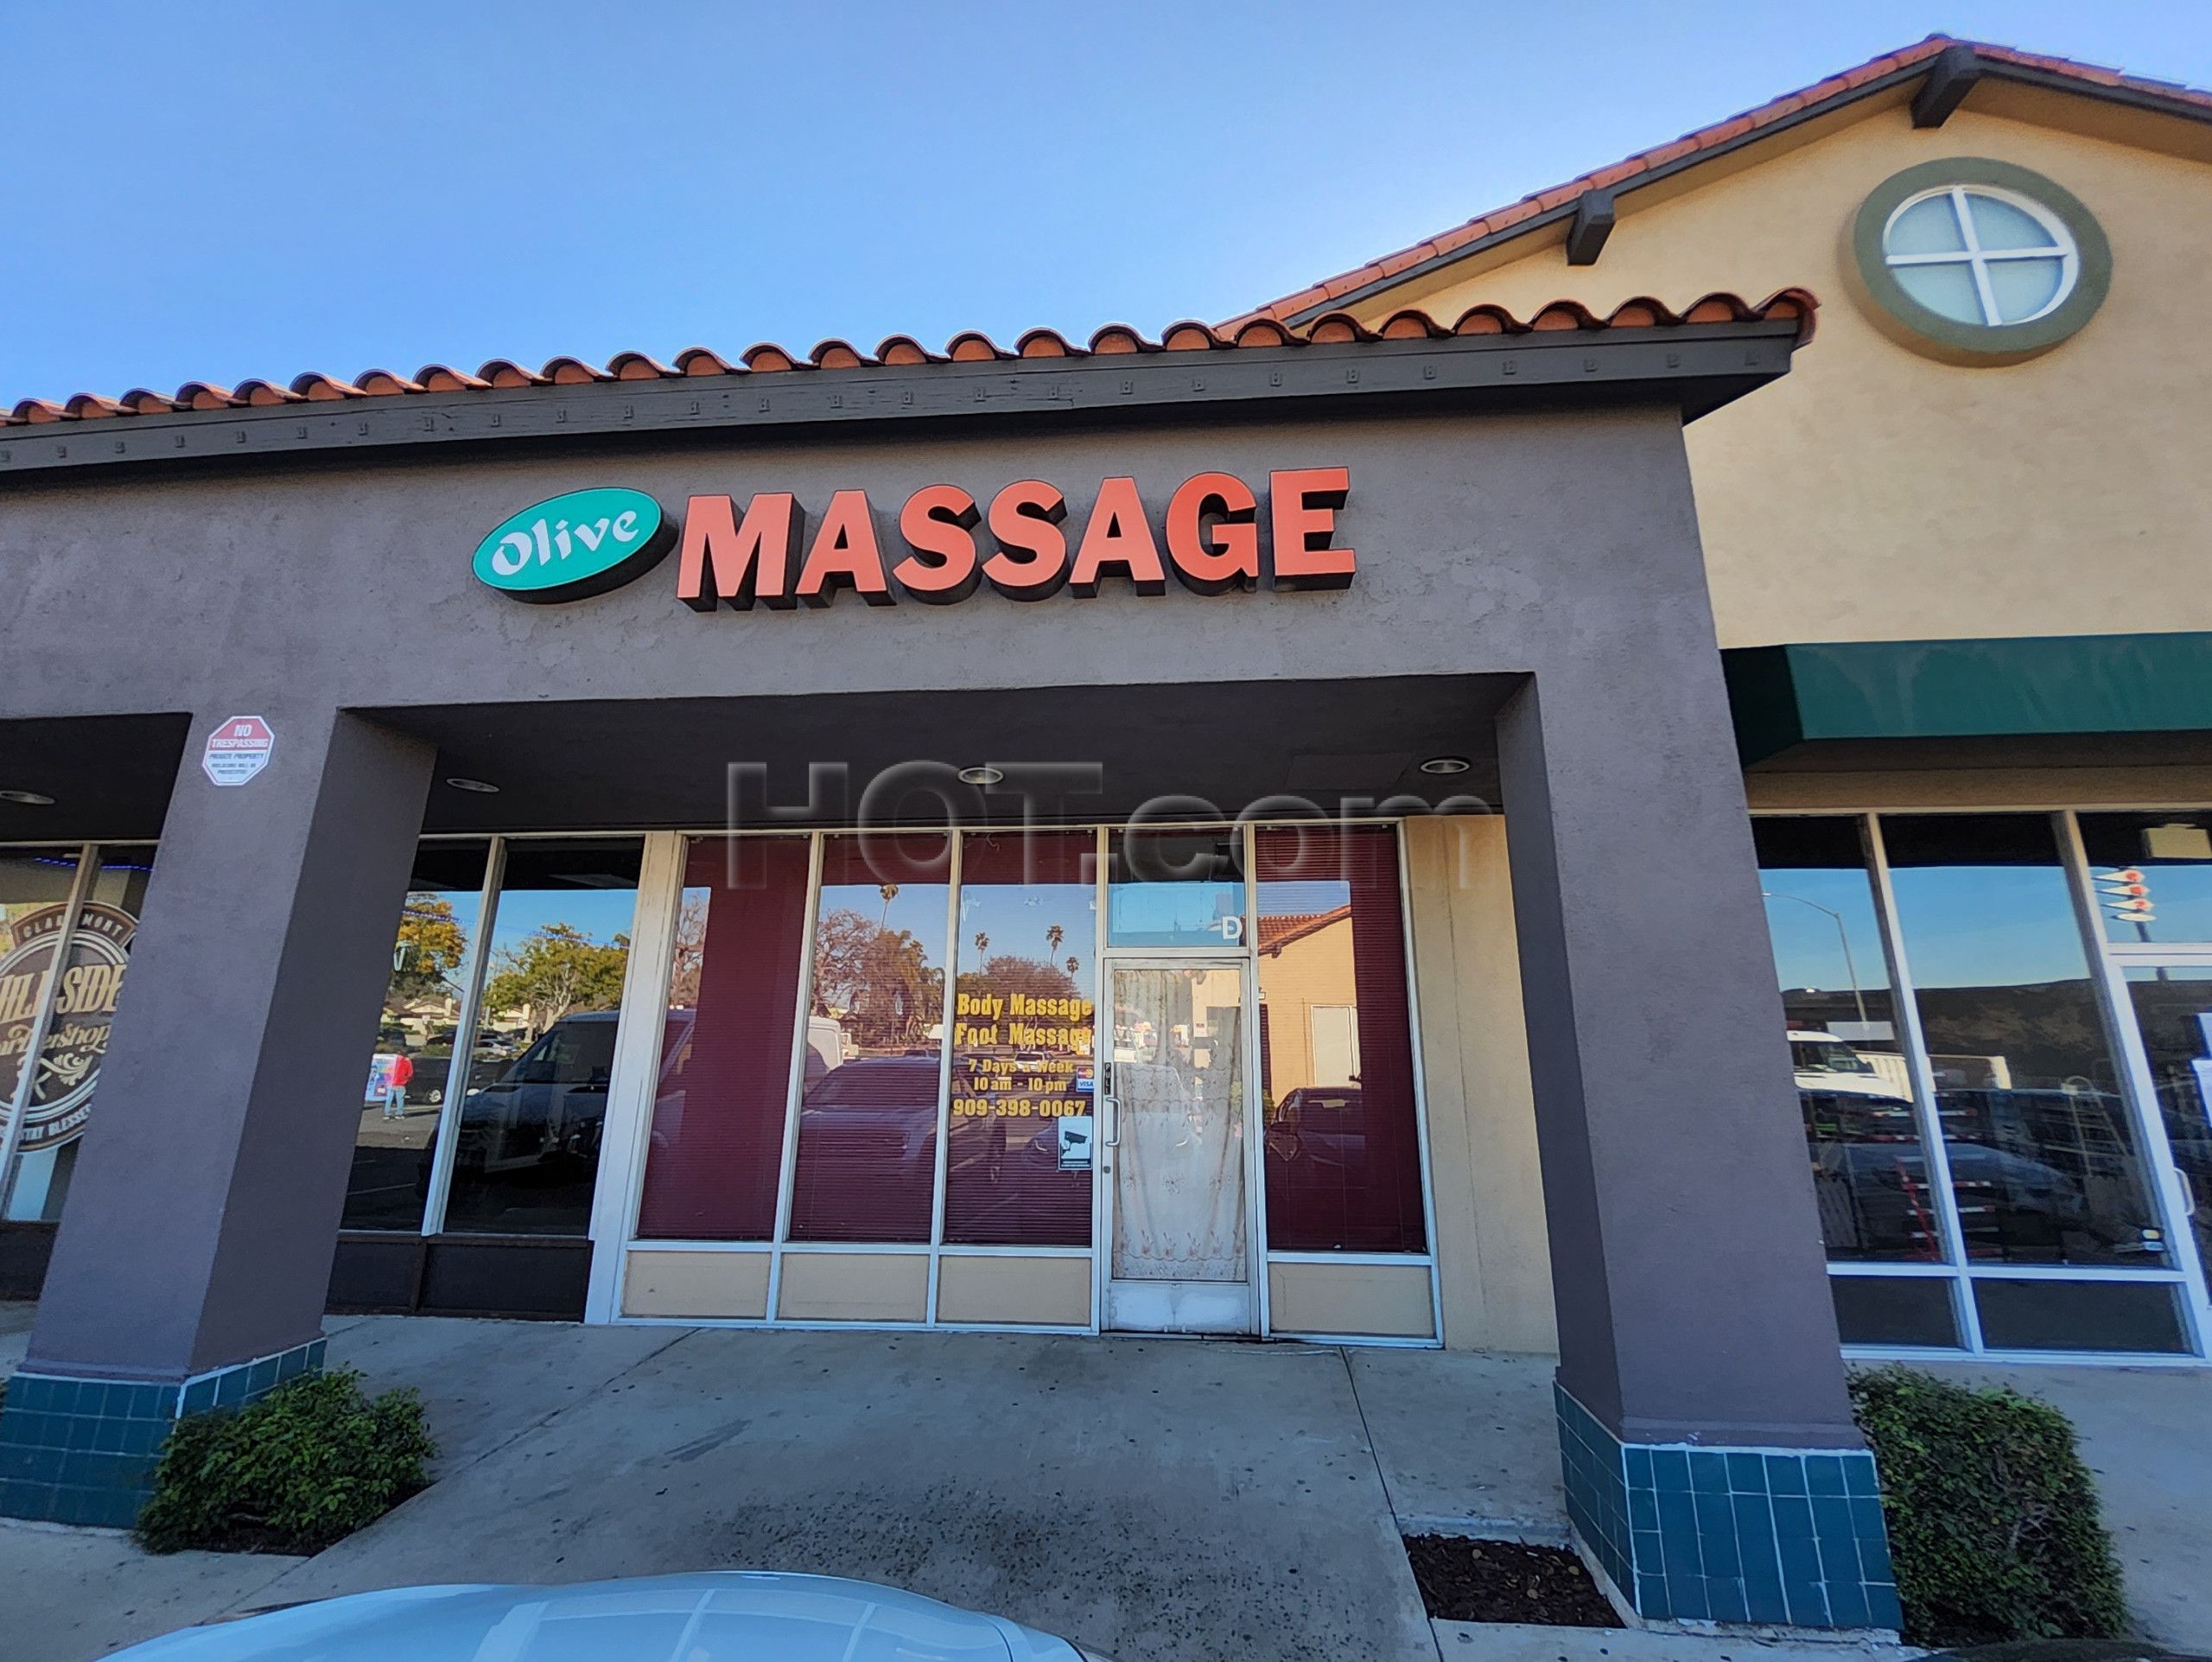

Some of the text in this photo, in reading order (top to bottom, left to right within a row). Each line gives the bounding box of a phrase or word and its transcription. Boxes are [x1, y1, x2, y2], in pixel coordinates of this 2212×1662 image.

[492, 510, 639, 576] Olive
[677, 467, 1357, 603] MASSAGE
[234, 724, 252, 737] NO
[212, 738, 270, 748] TRESPASSING
[22, 913, 123, 938] CLARMONT
[1222, 915, 1243, 939] D
[957, 993, 1093, 1022] Body Massage
[954, 1022, 1092, 1052] Foot Massage
[969, 1059, 977, 1073] 7
[982, 1059, 1017, 1075] Days
[1037, 1060, 1075, 1073] Week
[974, 1077, 988, 1091] 10
[990, 1079, 1013, 1091] am
[1028, 1077, 1044, 1091] 10
[1045, 1079, 1068, 1094] pm
[953, 1098, 1086, 1118] 909-398-0067
